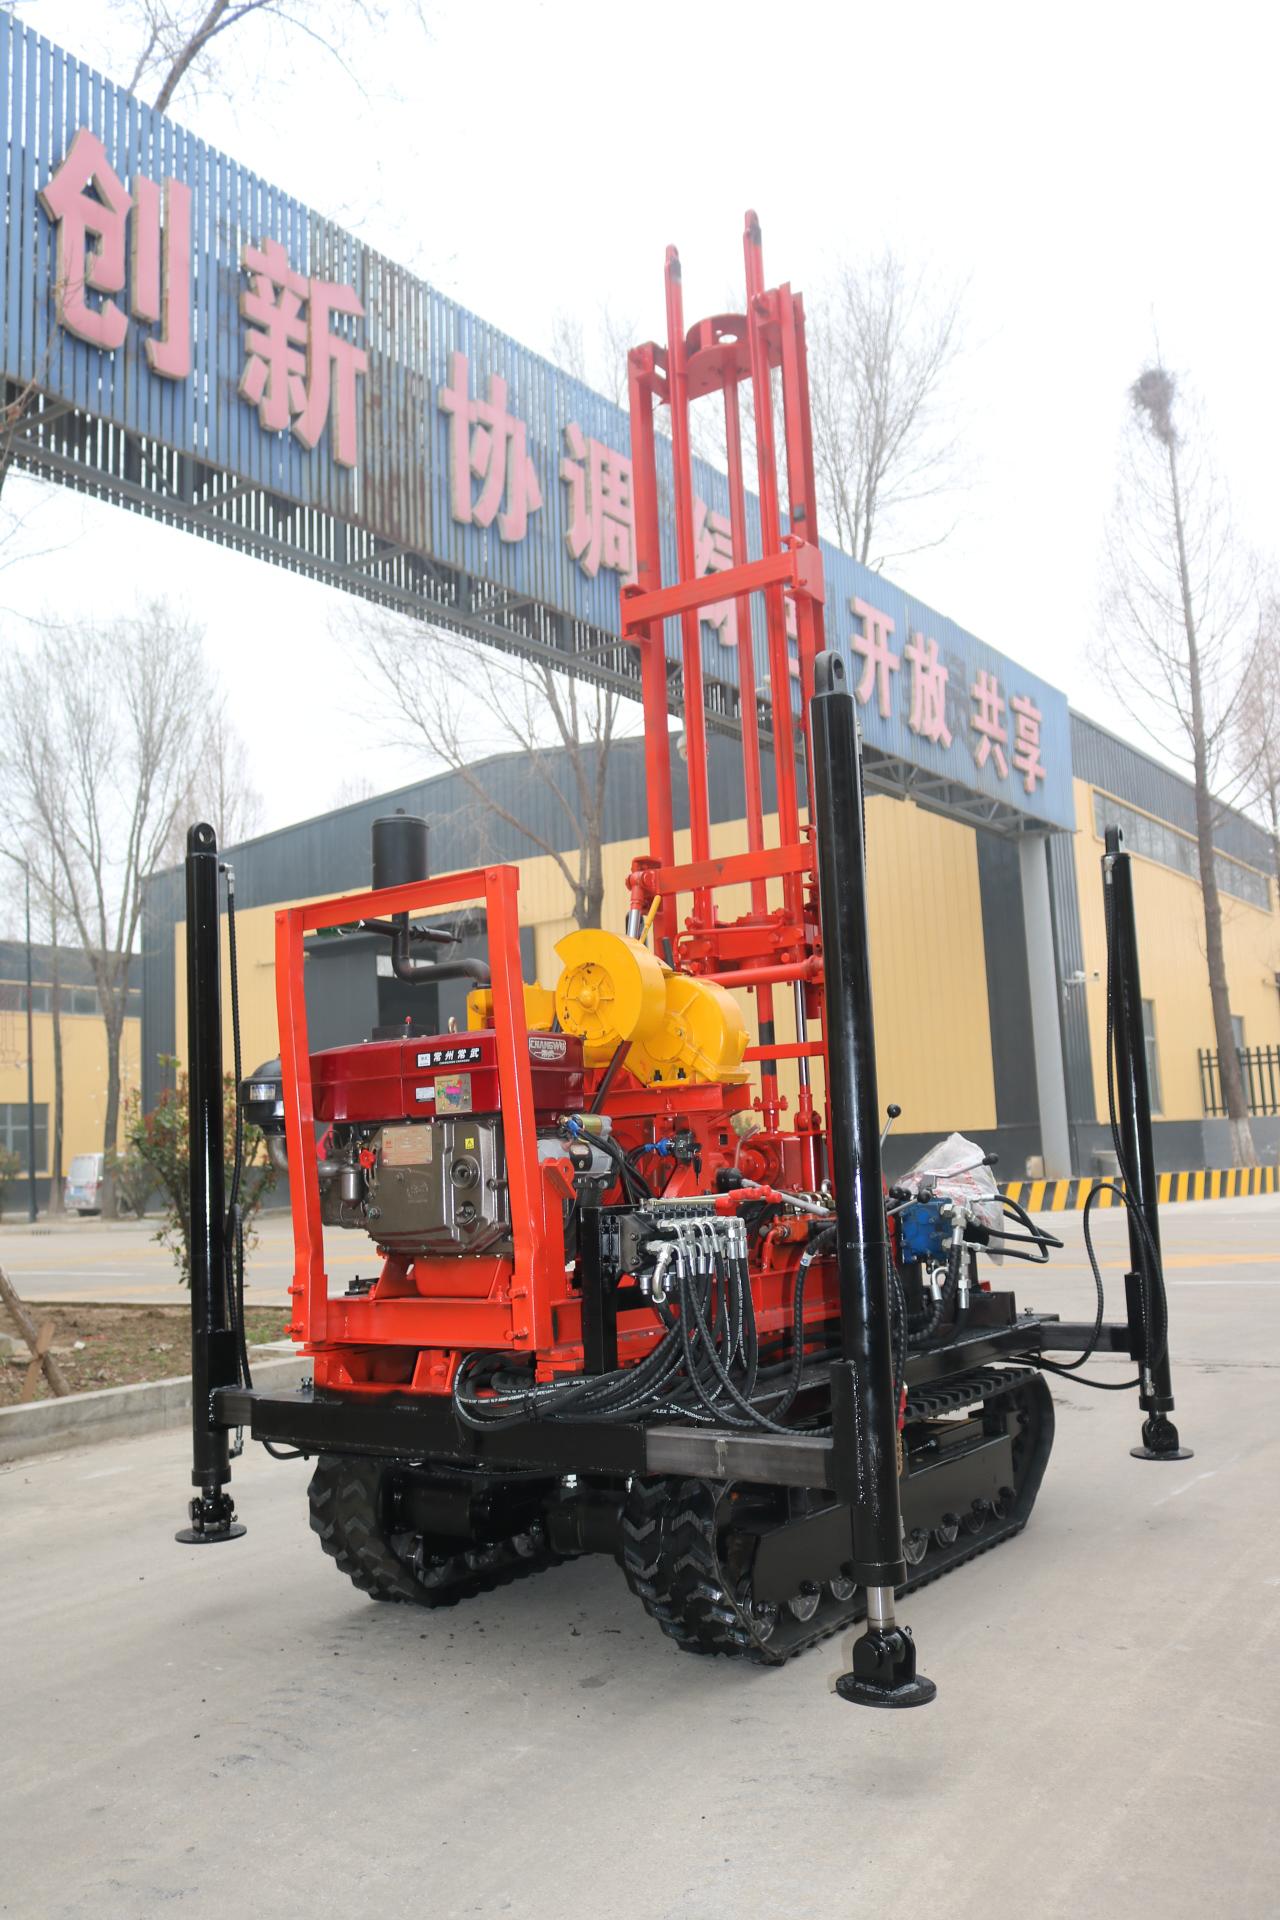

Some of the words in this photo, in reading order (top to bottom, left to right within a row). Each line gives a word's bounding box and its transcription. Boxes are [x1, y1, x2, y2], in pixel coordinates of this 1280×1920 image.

[38, 126, 368, 469] 创新
[438, 350, 637, 586] 协调
[851, 596, 952, 749] 开放
[970, 669, 1047, 794] 共享
[433, 1047, 480, 1061] 常州常武
